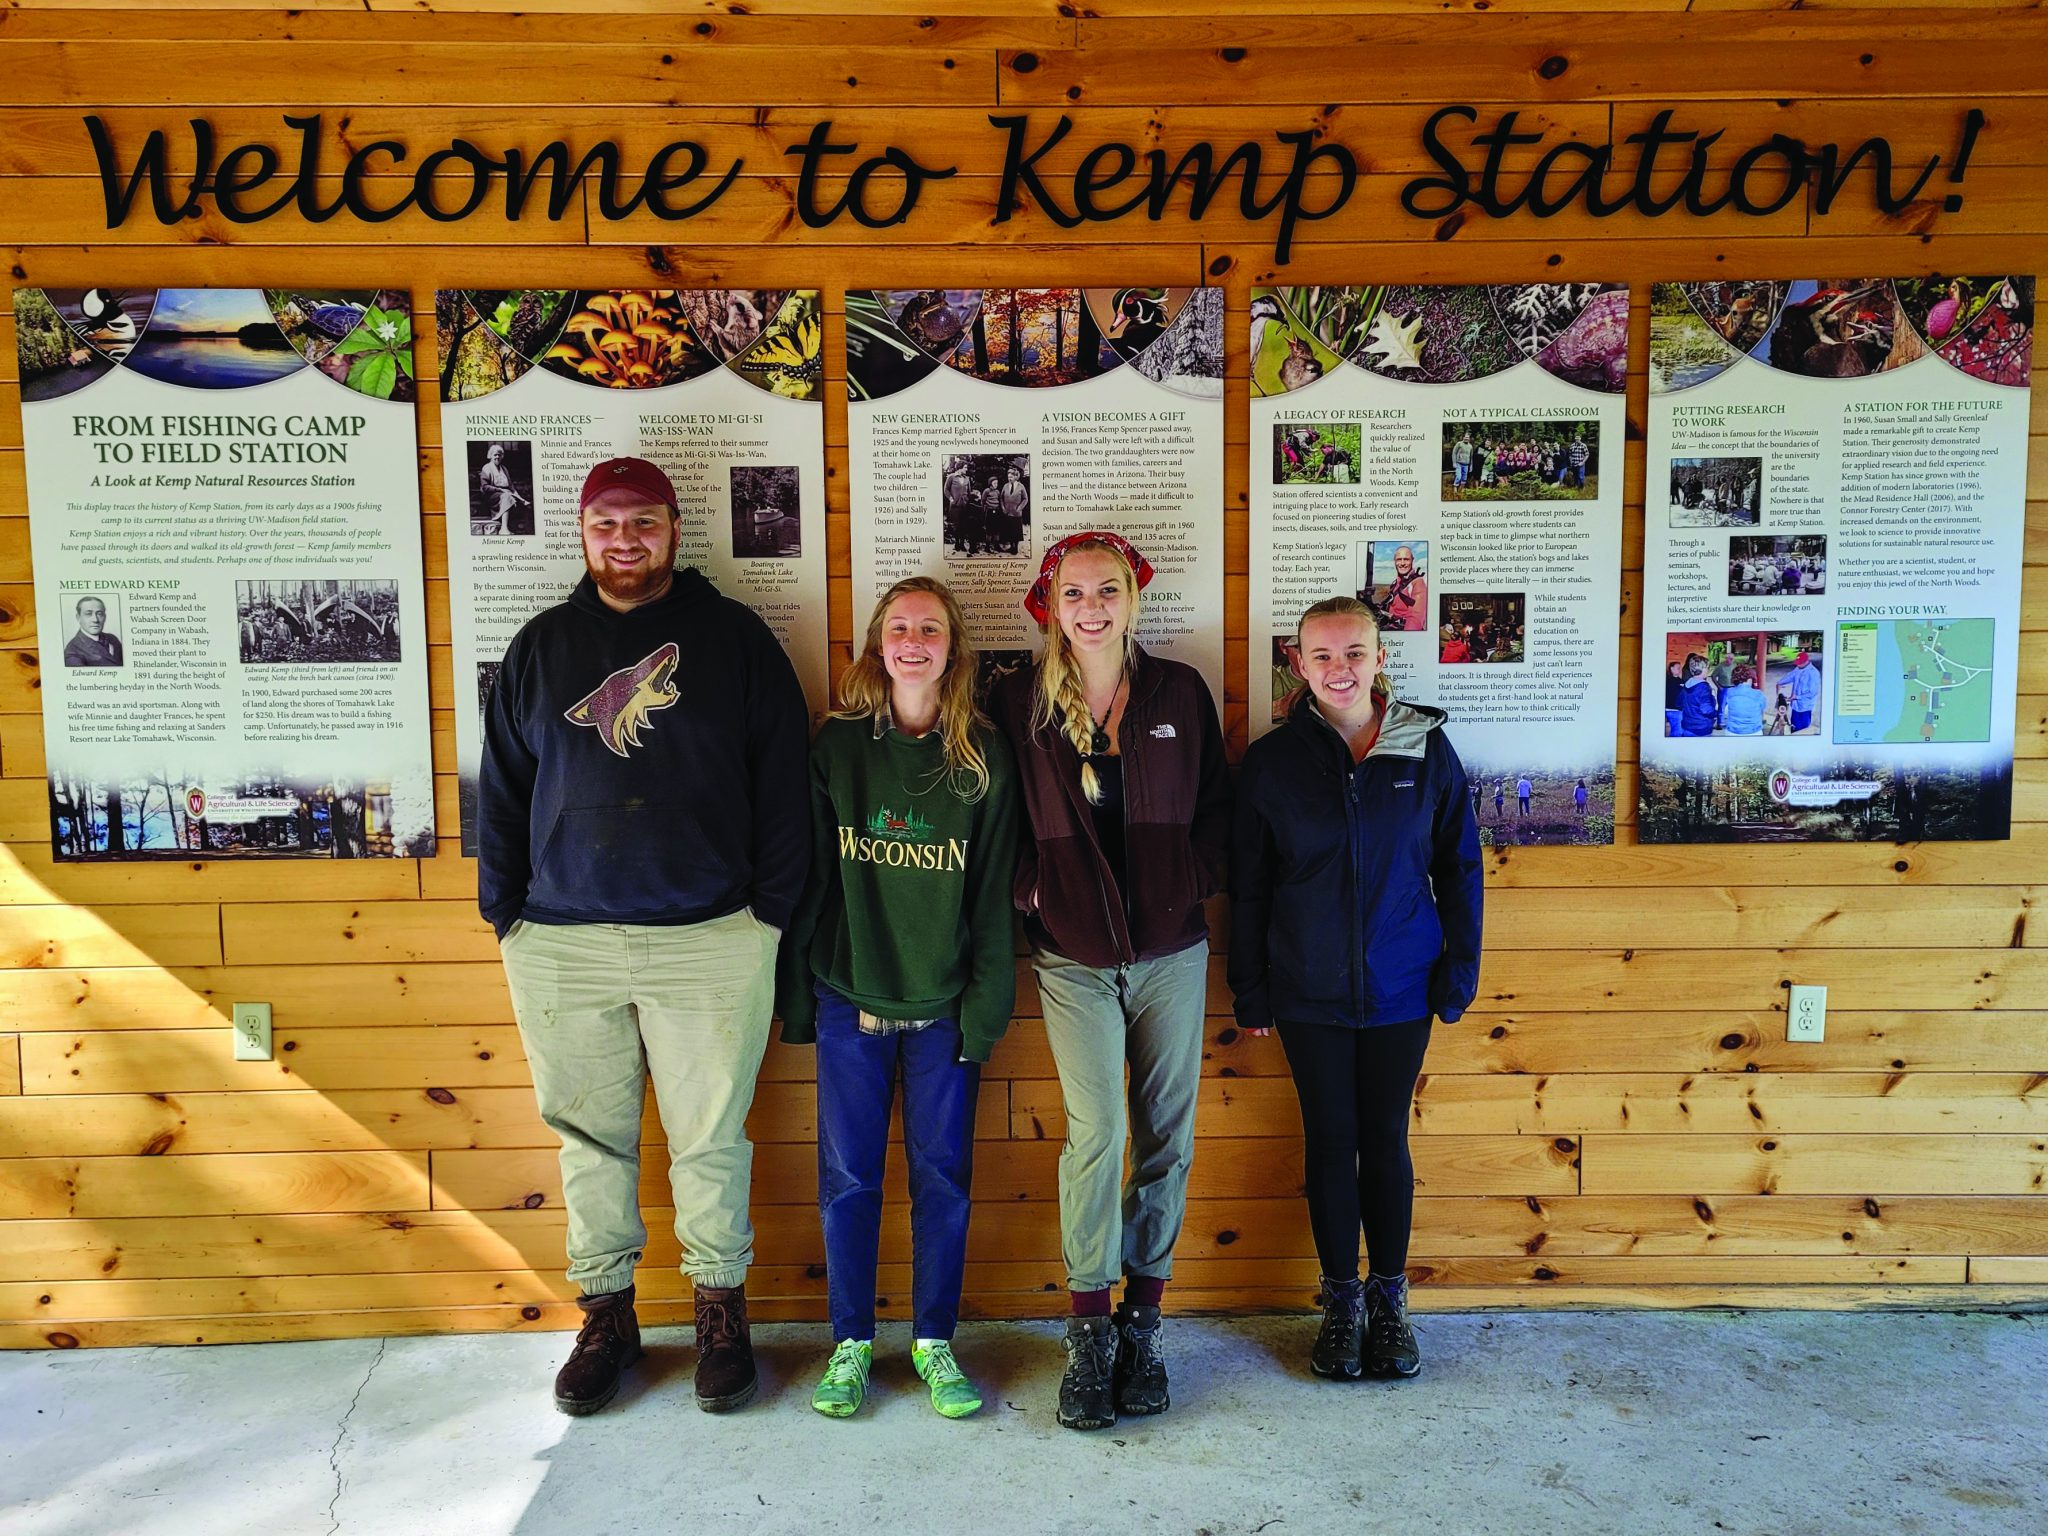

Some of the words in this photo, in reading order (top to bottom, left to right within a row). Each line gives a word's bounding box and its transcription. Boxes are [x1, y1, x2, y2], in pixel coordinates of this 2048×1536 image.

[83, 114, 744, 229] Welcome
[785, 121, 957, 229] to
[987, 112, 1357, 265] Kemp
[1400, 105, 1987, 218] Station!
[1673, 406, 1724, 416] PUTTING
[1727, 405, 1785, 415] RESEARCH
[1844, 404, 1852, 412] A
[1855, 403, 1904, 412] STATION
[1906, 402, 1928, 411] FOR
[1931, 402, 1954, 410] THE
[1958, 401, 2003, 410] FUTURE
[1042, 414, 1049, 422] A
[1052, 413, 1091, 422] VISION
[1094, 412, 1146, 422] BECOMES
[1149, 413, 1157, 421] A
[1160, 412, 1186, 421] GIFT
[1274, 411, 1281, 420] A
[1284, 410, 1328, 419] LEGACY
[1331, 410, 1346, 419] OF
[1348, 410, 1406, 419] RESEARCH
[1443, 409, 1468, 418] NOT
[1470, 409, 1478, 417] A
[1480, 408, 1528, 417] TYPICAL
[1531, 407, 1599, 417] CLASSROOM
[466, 416, 509, 424] MINNIE
[512, 415, 537, 424] AND
[540, 415, 591, 424] FRANCES
[639, 415, 698, 424] WELCOME
[699, 415, 715, 424] TO
[718, 415, 763, 424] MI-GI-SI
[872, 415, 898, 423] NEW
[901, 414, 980, 423] GENERATIONS
[1672, 418, 1688, 427] TO
[1691, 418, 1726, 427] WORK
[1897, 415, 1917, 423] Small
[1934, 414, 1952, 423] Sally
[1953, 413, 1989, 422] Greenleaf
[73, 416, 154, 436] FROM
[162, 416, 277, 436] FISHING
[285, 416, 366, 436] CAMP
[640, 426, 713, 436] WAS-ISS-WAN
[902, 427, 922, 436] Kemp
[955, 426, 977, 436] Egbert
[979, 427, 1007, 436] Spencer
[1099, 426, 1119, 435] Kemp
[1121, 426, 1148, 434] Spencer
[1150, 424, 1172, 434] passed
[1370, 422, 1412, 430] Researchers
[467, 427, 537, 436] PIONEERING
[540, 427, 582, 436] SPIRITS
[655, 439, 680, 449] Kemps
[681, 439, 710, 447] referred
[94, 443, 133, 463] TO
[141, 443, 221, 463] FIELD
[230, 443, 348, 463] STATION
[91, 475, 101, 487] A
[105, 475, 136, 487] Look
[139, 476, 152, 486] at
[156, 475, 192, 490] Kemp
[195, 475, 244, 486] Natural
[247, 475, 308, 486] Resources
[311, 475, 355, 486] Station
[1441, 511, 1462, 520] Kemp
[1463, 510, 1491, 518] Station's
[1492, 509, 1531, 519] old-growth
[1554, 509, 1584, 518] provides
[506, 538, 525, 547] Kemp
[473, 564, 505, 572] northern
[60, 580, 91, 590] MEET
[94, 580, 145, 589] EDWARD
[148, 580, 180, 589] KEMP
[159, 593, 181, 602] Kemp
[1150, 592, 1181, 601] BORN
[130, 606, 160, 614] partners
[162, 604, 192, 612] founded
[1837, 606, 1886, 616] FINDING
[1889, 606, 1920, 615] YOUR
[1923, 605, 1946, 614] WAY
[131, 627, 167, 636] Company
[192, 638, 211, 647] They
[99, 670, 118, 678] Kemp
[301, 688, 338, 698] purchased
[838, 826, 968, 872] WSCONSIN
